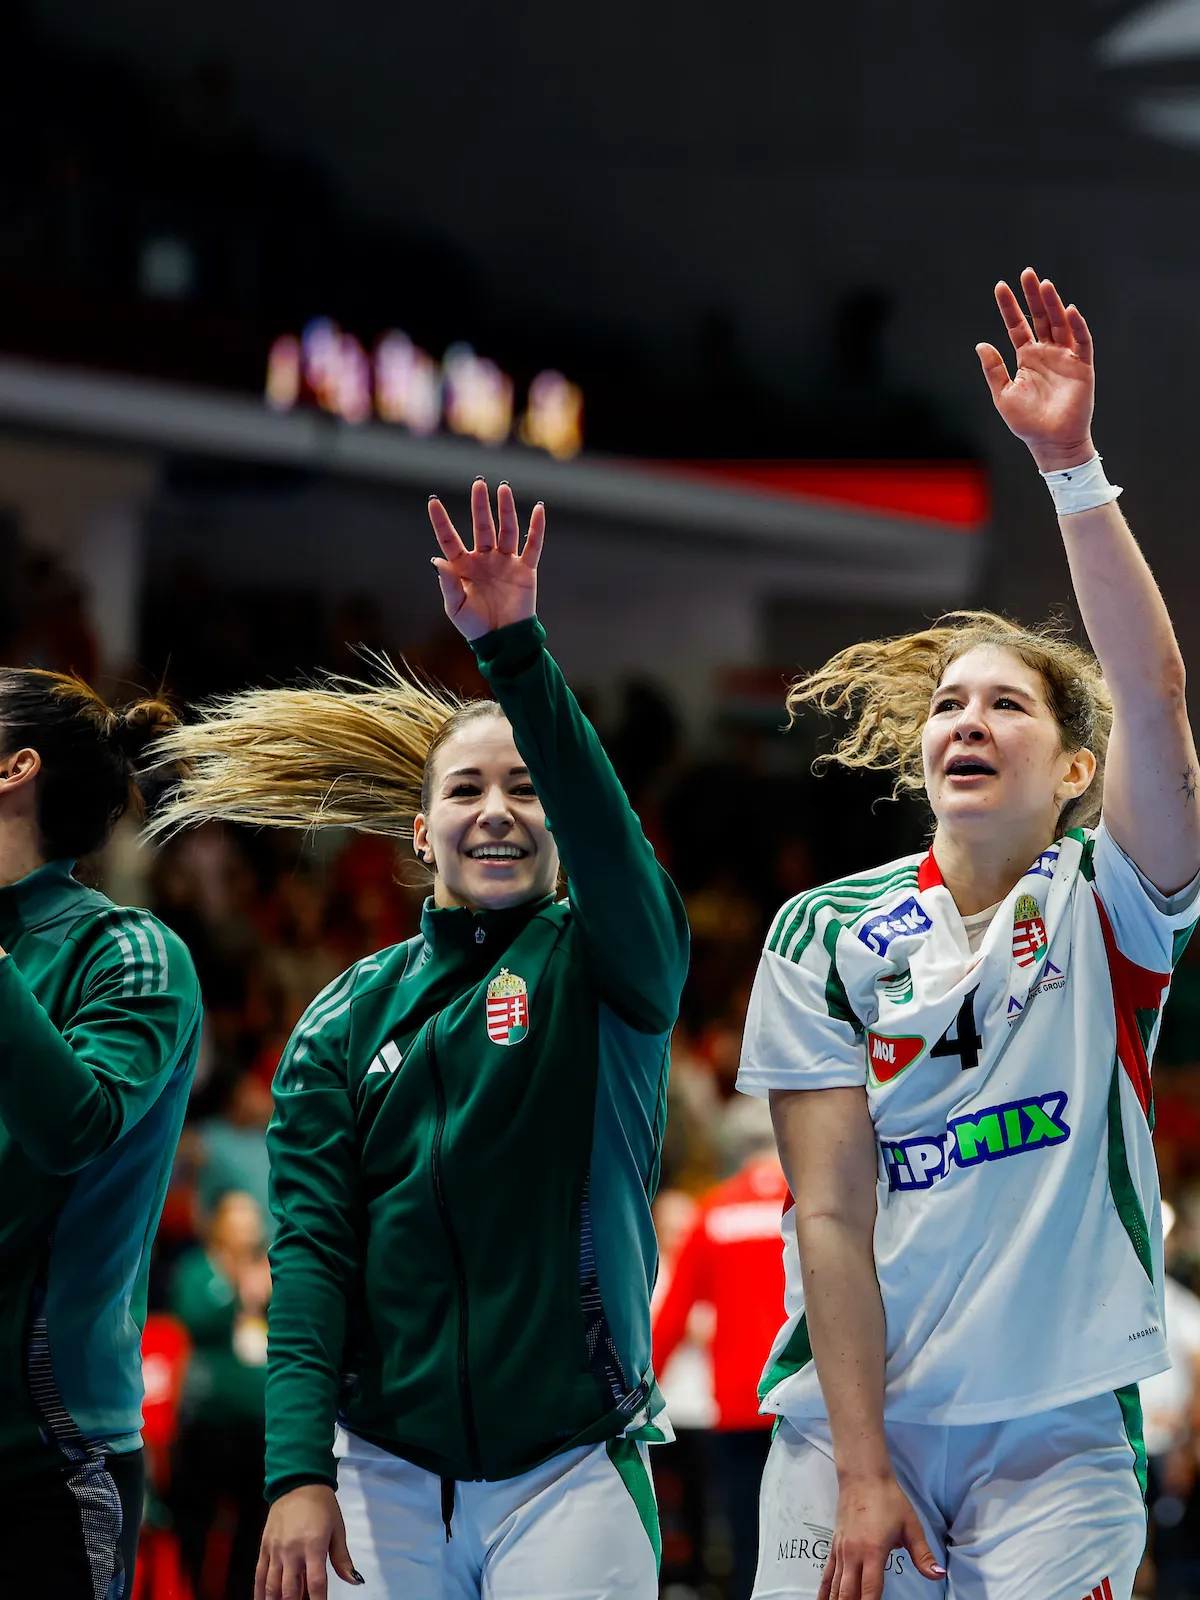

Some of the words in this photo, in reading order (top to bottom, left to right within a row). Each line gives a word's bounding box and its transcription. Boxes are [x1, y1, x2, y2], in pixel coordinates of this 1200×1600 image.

[866, 905, 927, 953] JYSK
[930, 982, 982, 1071] 4
[872, 1038, 896, 1064] MOL
